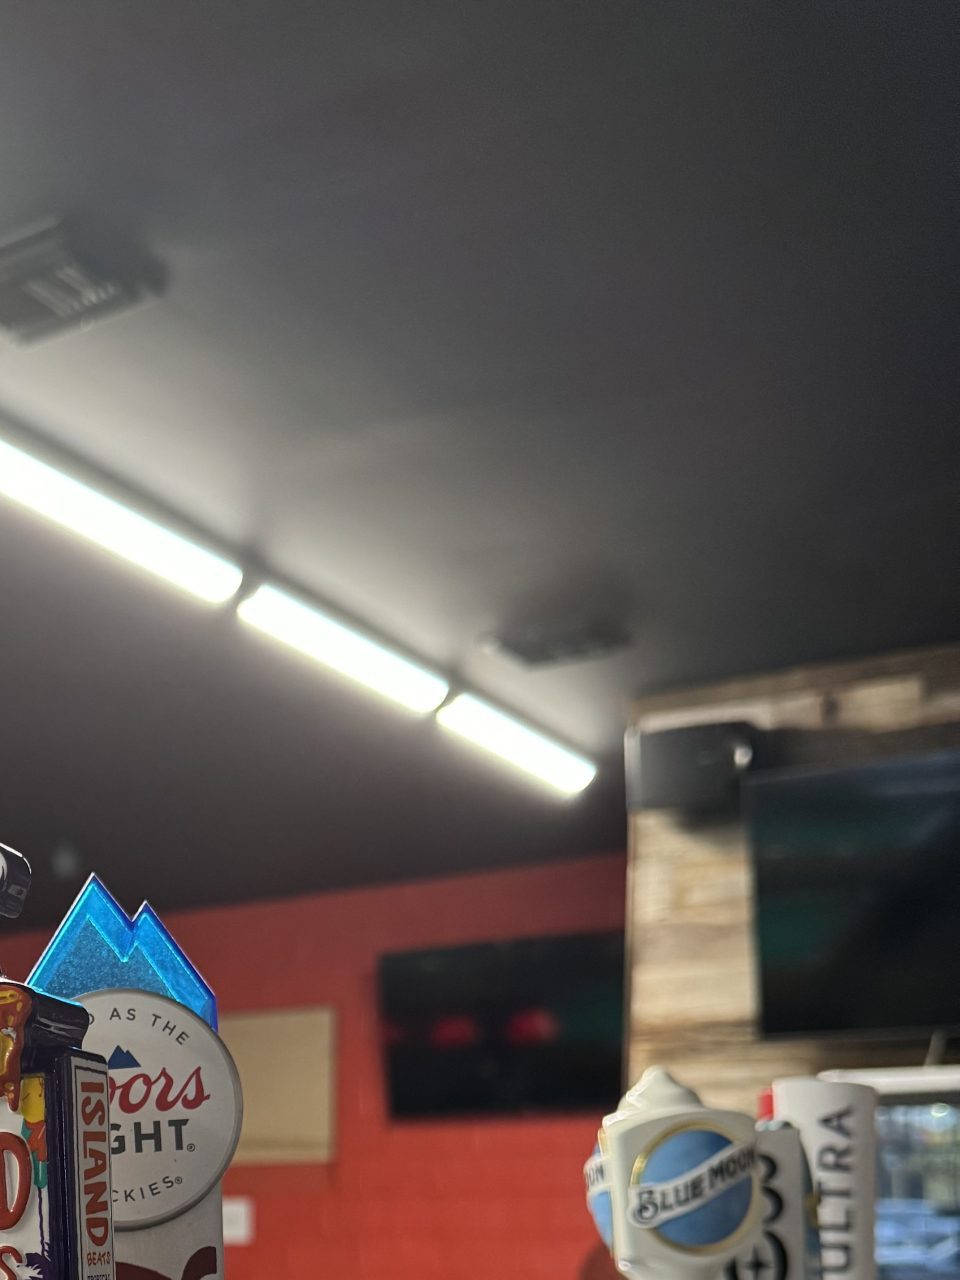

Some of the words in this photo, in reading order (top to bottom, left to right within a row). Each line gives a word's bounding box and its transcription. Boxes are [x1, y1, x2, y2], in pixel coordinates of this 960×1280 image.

[110, 1008, 136, 1020] AS
[151, 1014, 189, 1045] THE
[81, 1082, 109, 1247] ISLAND
[818, 1104, 852, 1274] ULTRA
[87, 1251, 111, 1266] BEATS
